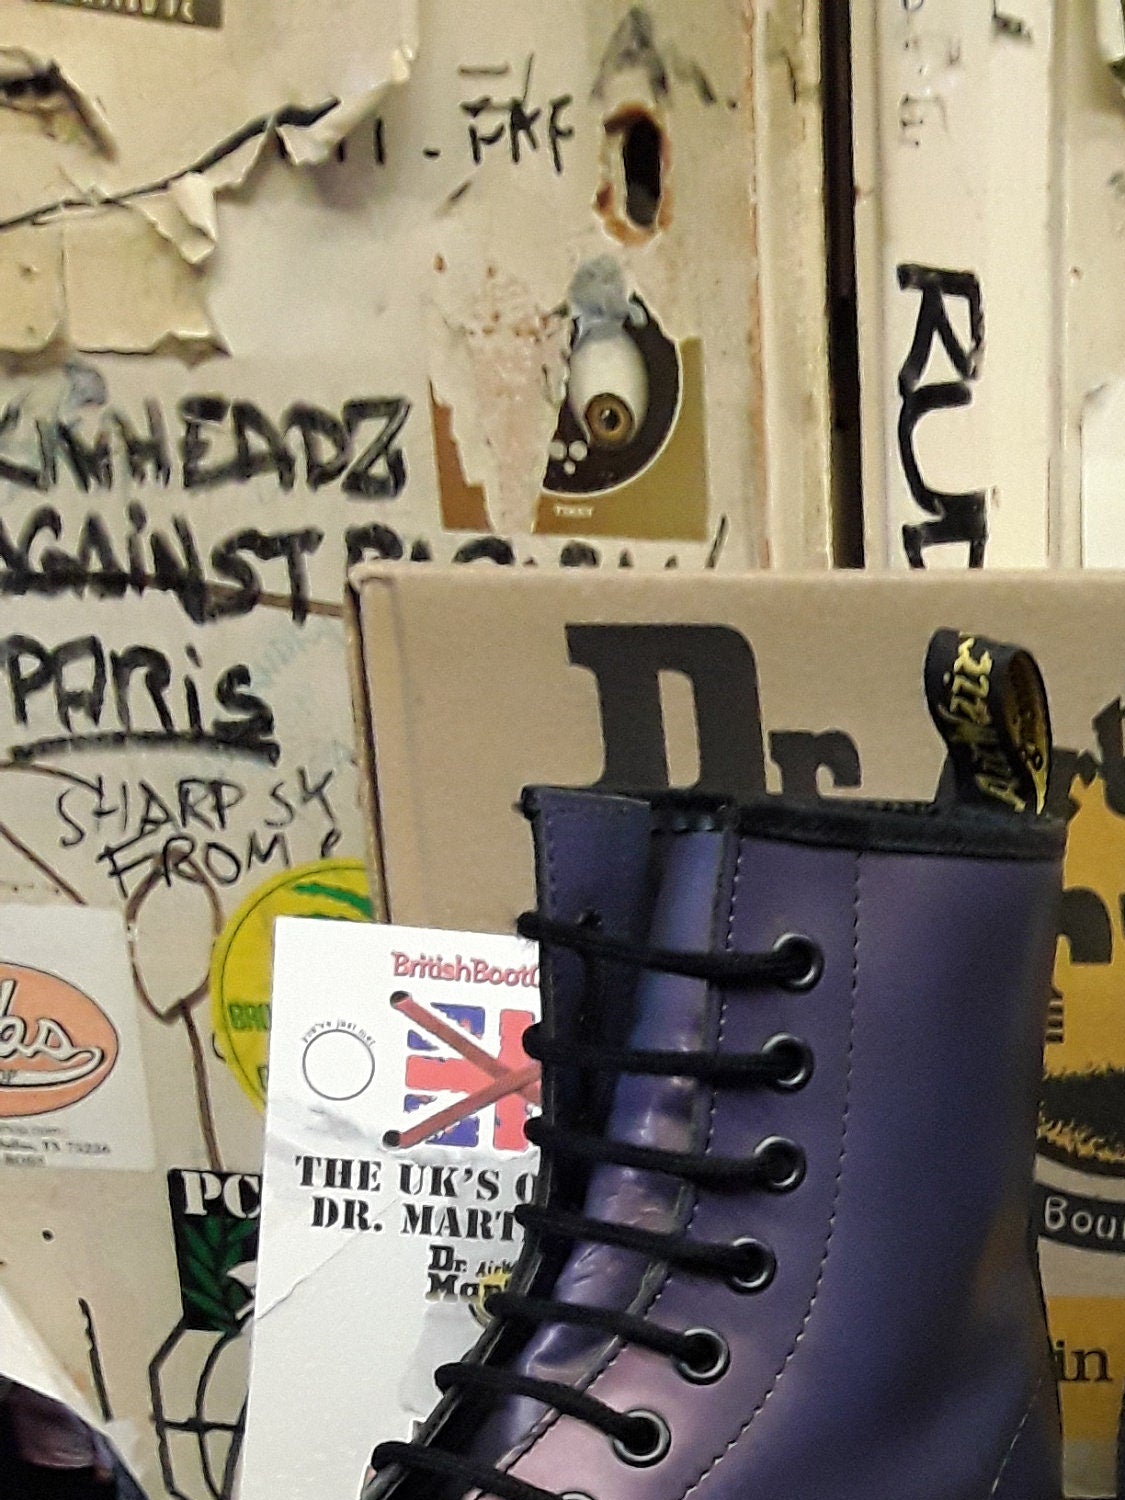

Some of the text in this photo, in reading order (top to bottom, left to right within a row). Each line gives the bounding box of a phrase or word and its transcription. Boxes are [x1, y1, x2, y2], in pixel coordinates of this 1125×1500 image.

[565, 622, 862, 790] Dr
[295, 1155, 381, 1193] THE
[398, 1163, 499, 1201] UK'S
[310, 1196, 383, 1232] DR.
